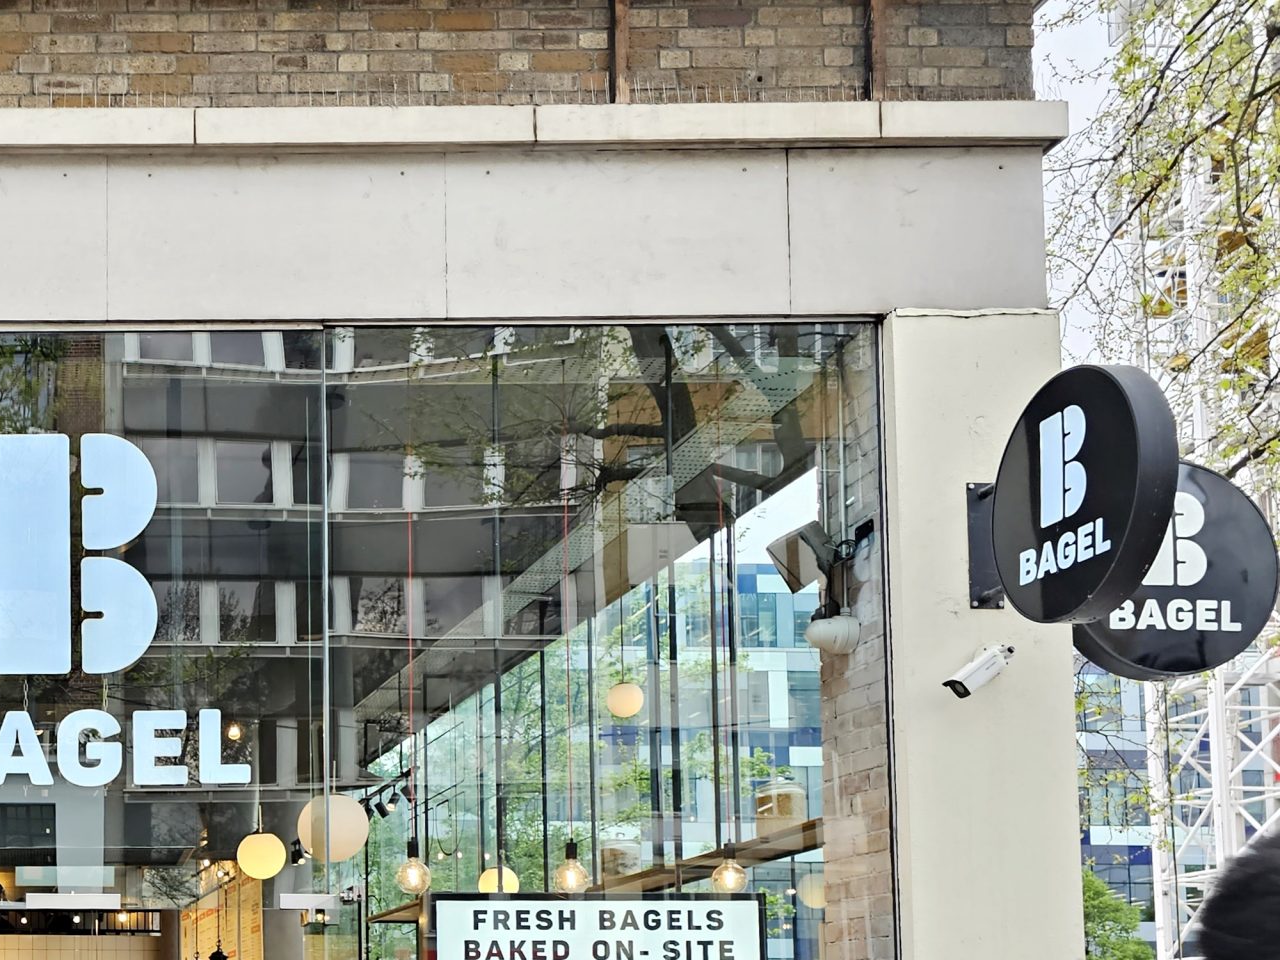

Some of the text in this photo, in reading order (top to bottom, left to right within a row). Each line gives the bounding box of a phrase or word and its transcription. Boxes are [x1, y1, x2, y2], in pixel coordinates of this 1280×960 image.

[1039, 404, 1087, 528] B
[1019, 517, 1112, 587] BAGEL
[1109, 599, 1242, 632] BAGEL
[472, 909, 724, 931] FRESH BAGELS
[463, 940, 570, 960] BAKED
